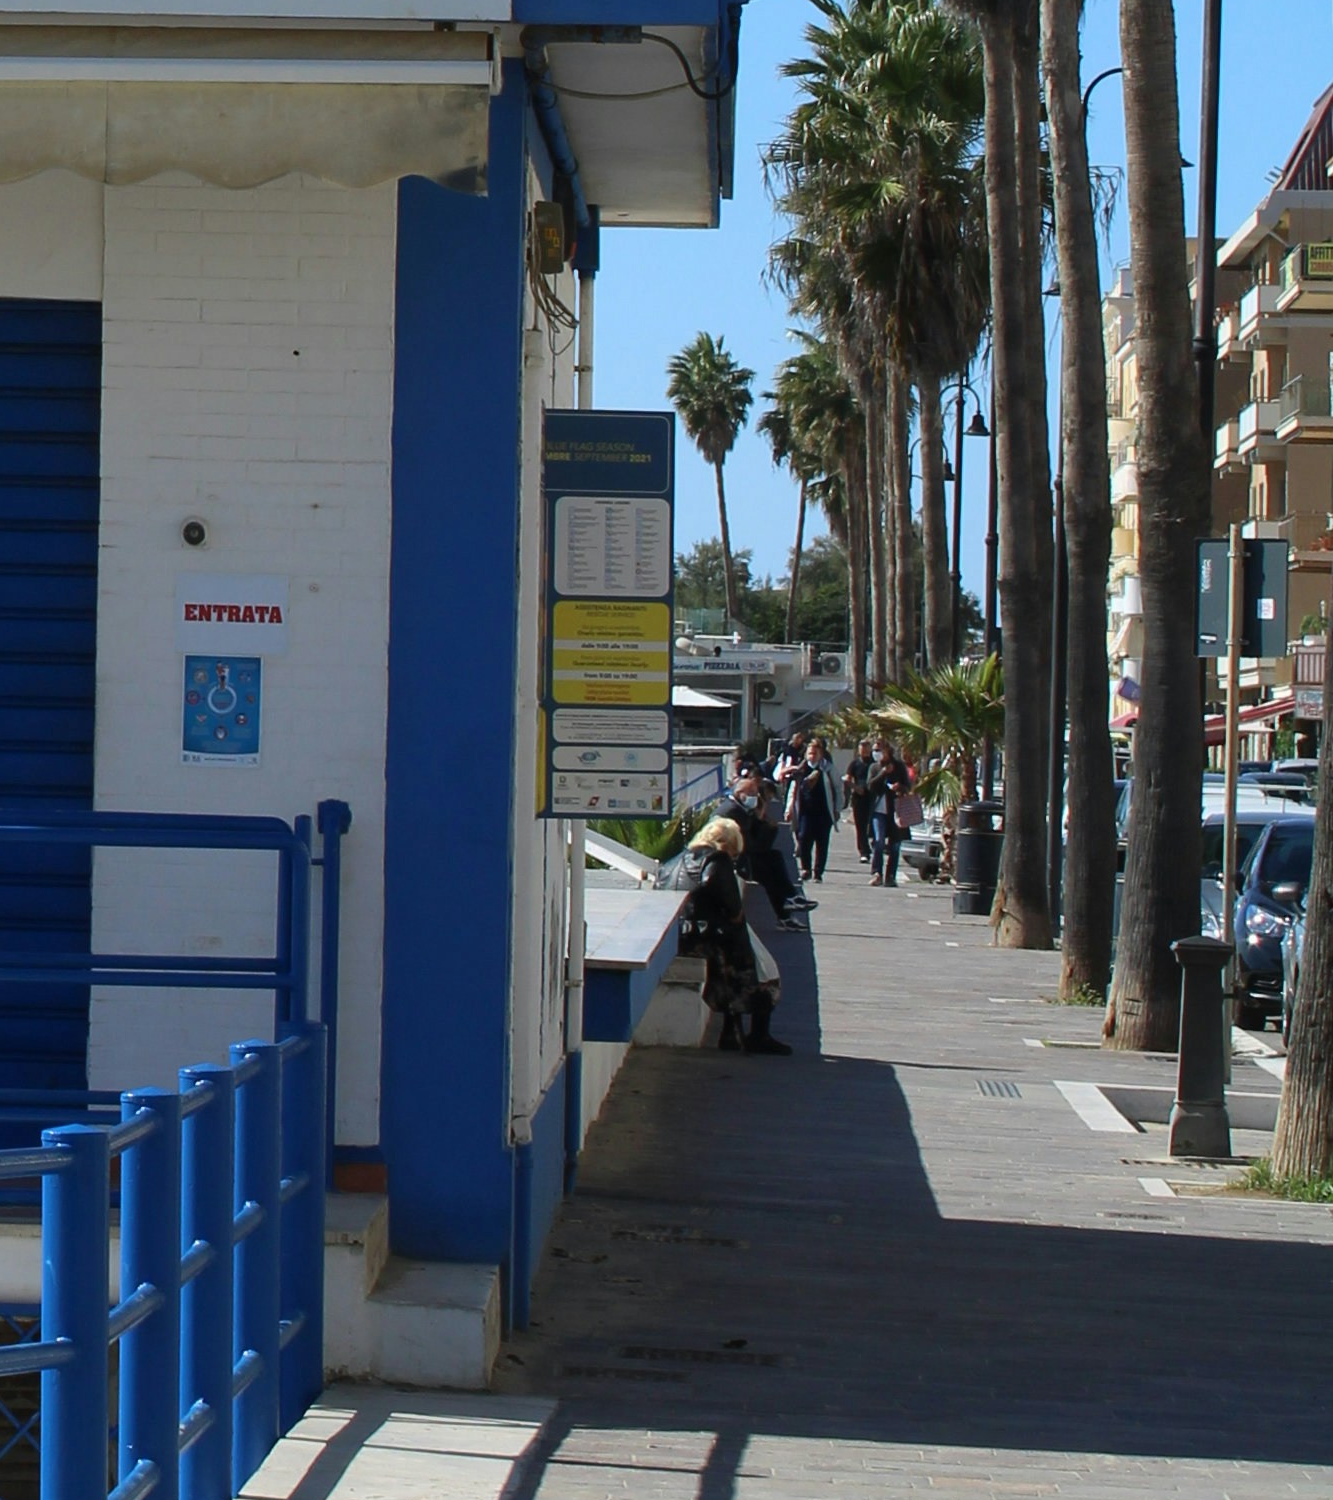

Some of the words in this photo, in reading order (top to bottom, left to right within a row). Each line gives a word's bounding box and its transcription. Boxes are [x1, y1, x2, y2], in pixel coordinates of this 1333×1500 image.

[629, 454, 652, 462] 2021
[184, 603, 283, 624] ENTRATA
[704, 662, 740, 670] PIZZERIA
